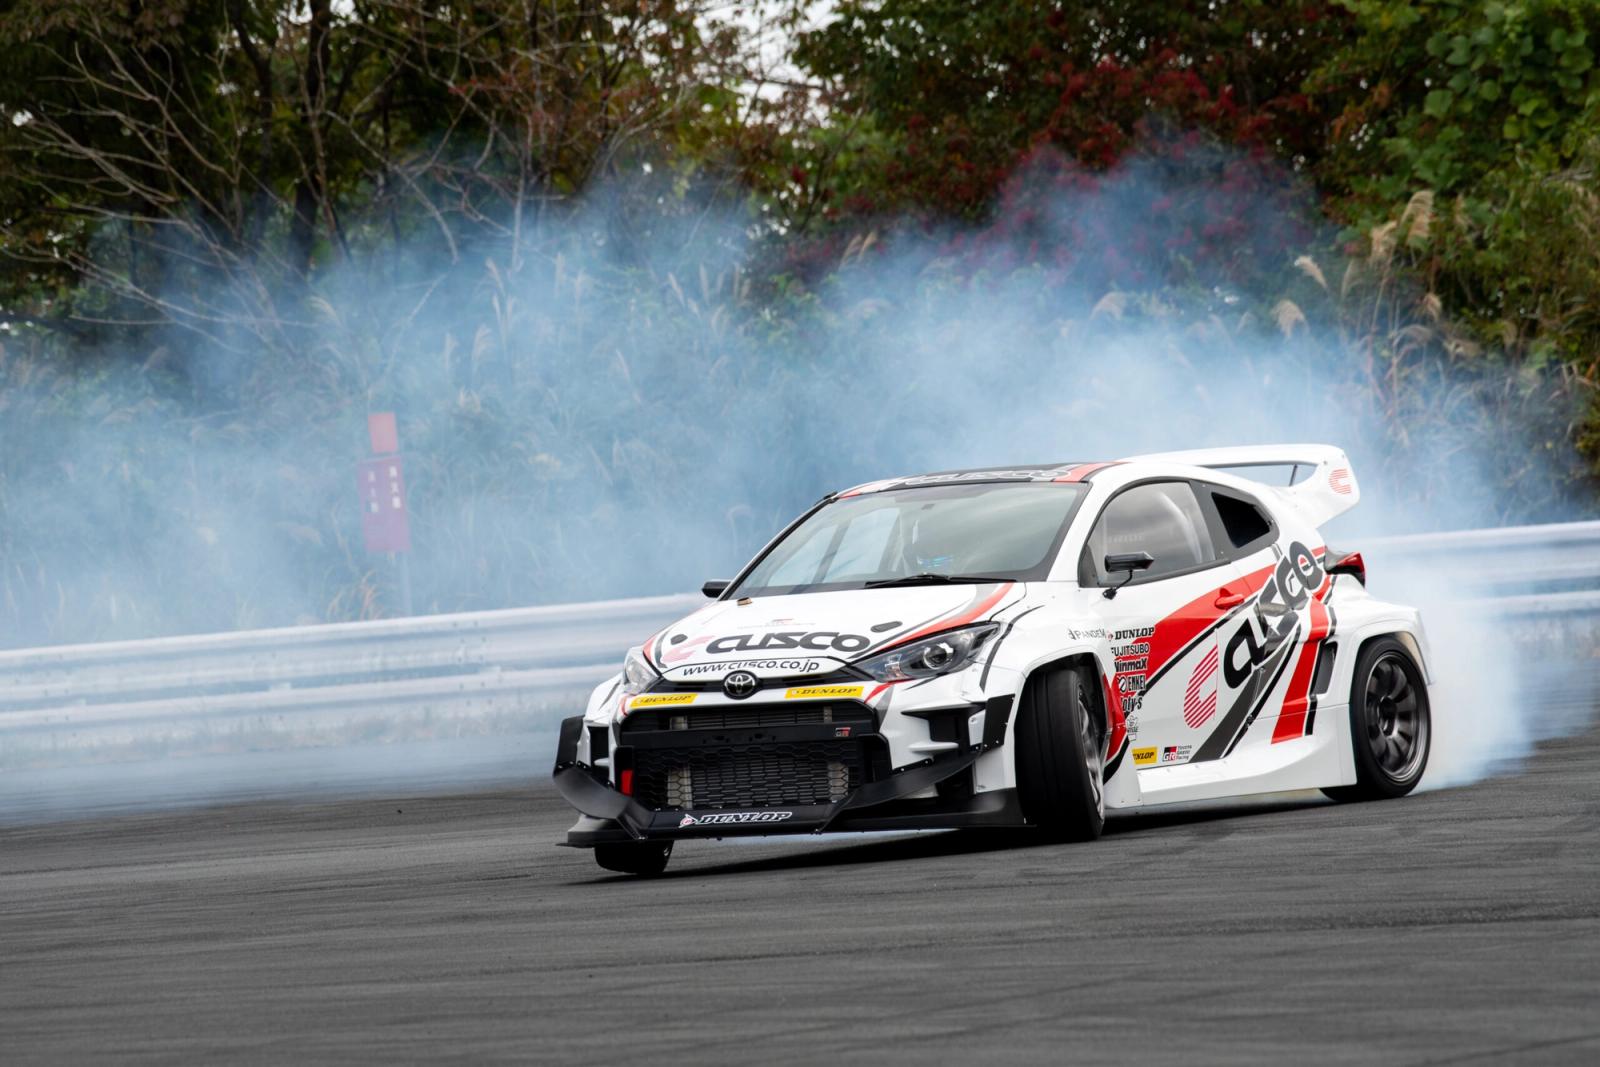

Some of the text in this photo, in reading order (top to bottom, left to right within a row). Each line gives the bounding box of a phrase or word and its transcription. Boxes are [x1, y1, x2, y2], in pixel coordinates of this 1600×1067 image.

[1114, 627, 1154, 640] DUNLOP
[706, 631, 870, 654] CUSCO
[1111, 643, 1149, 656] FUJITSUBO
[683, 659, 819, 676] www.cusco.co.jp
[643, 695, 692, 703] DUNLOP
[697, 811, 793, 824] DUNLOP
